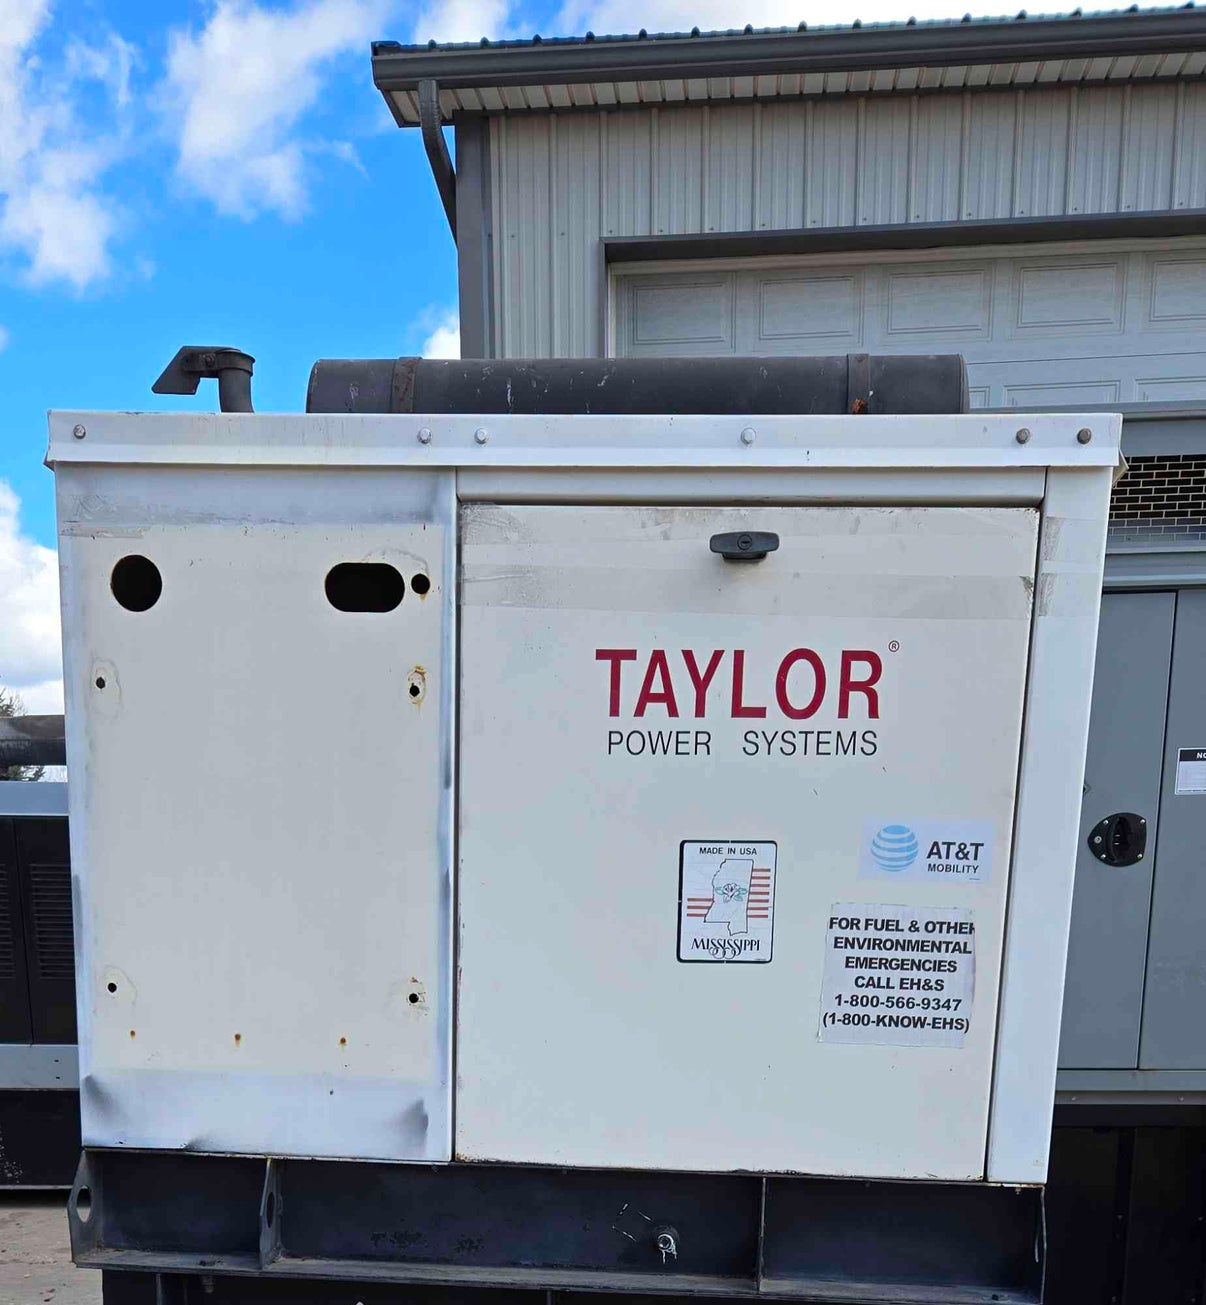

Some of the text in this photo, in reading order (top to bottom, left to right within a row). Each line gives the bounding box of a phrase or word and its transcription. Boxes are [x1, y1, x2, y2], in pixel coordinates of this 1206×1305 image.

[595, 647, 883, 720] TAYLOR
[607, 730, 878, 757] POWER SYSTEMS
[699, 847, 724, 855] MADE
[926, 841, 984, 861] AT&T
[927, 863, 979, 874] MOBILITY
[829, 917, 861, 931] FOR
[864, 918, 904, 933] FUEL
[908, 920, 920, 933] &
[691, 938, 760, 959] MISSISSIPPI
[833, 936, 973, 955] ENVIRONMENTAL
[844, 956, 958, 973] EMERGENCIES
[854, 976, 945, 992] CALL EH&S
[834, 994, 962, 1012] 1-800-566-9347
[822, 1012, 970, 1034] (1-800-KNOW-EHS)
